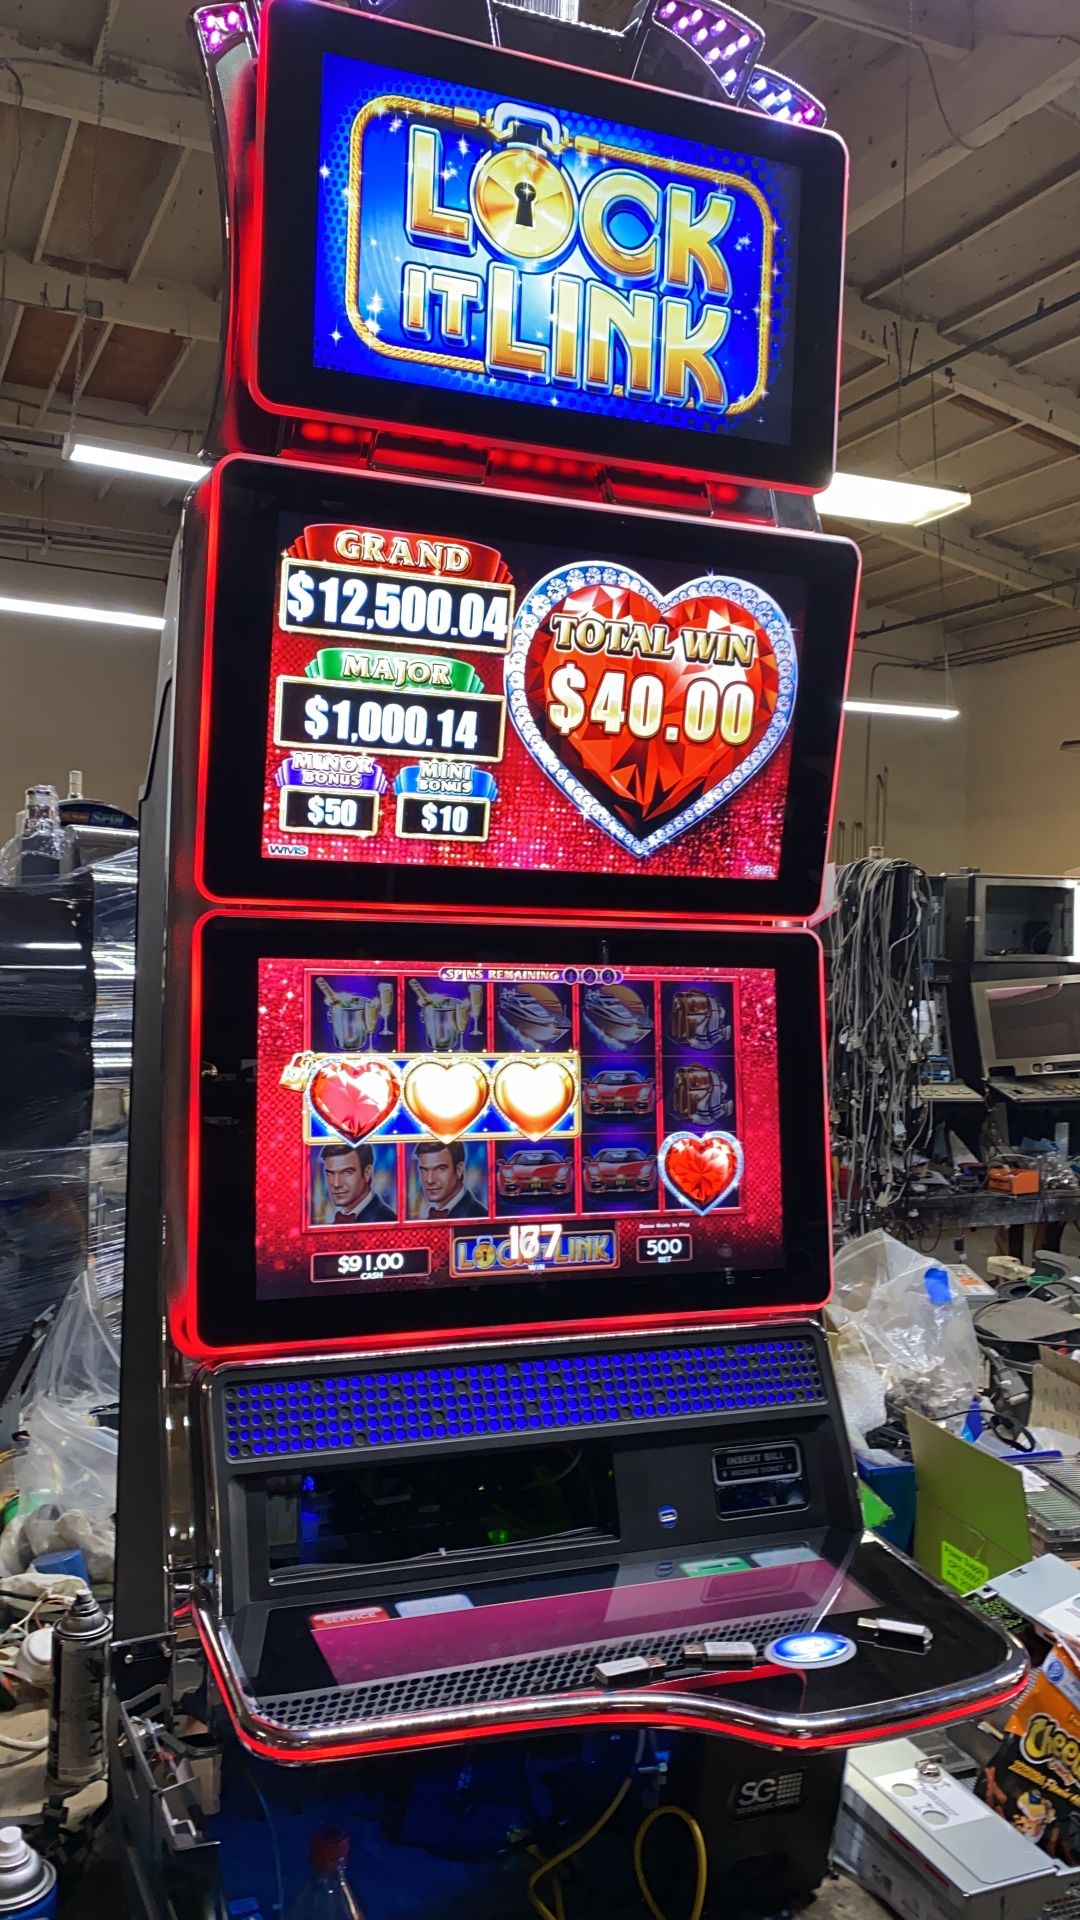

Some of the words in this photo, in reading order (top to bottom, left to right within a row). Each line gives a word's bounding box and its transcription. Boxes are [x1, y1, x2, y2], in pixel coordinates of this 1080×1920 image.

[407, 122, 736, 306] LOCK
[403, 262, 484, 347] IT
[484, 260, 731, 414] LINK
[334, 529, 472, 574] GRAND
[287, 570, 509, 641] $12,500.04
[552, 614, 676, 661] TOTAL
[680, 627, 755, 668] WIN
[342, 654, 452, 688] MAJOR
[548, 659, 757, 747] $40.00
[304, 694, 479, 750] $1,000.14
[291, 752, 376, 776] MINOR
[418, 760, 474, 782] MINI
[301, 770, 363, 788] BONUS
[417, 779, 473, 795] BONUS
[307, 795, 357, 827] $50
[421, 801, 469, 833] $10
[442, 968, 484, 982] SPINS
[487, 969, 560, 982] REMAINING
[646, 1238, 683, 1256] 500
[337, 1252, 404, 1274] $91.00
[360, 1271, 384, 1280] CASH
[726, 1453, 761, 1466] INSERT
[763, 1451, 785, 1462] BILL
[322, 1611, 378, 1625] SERVICE
[738, 1778, 777, 1806] SG
